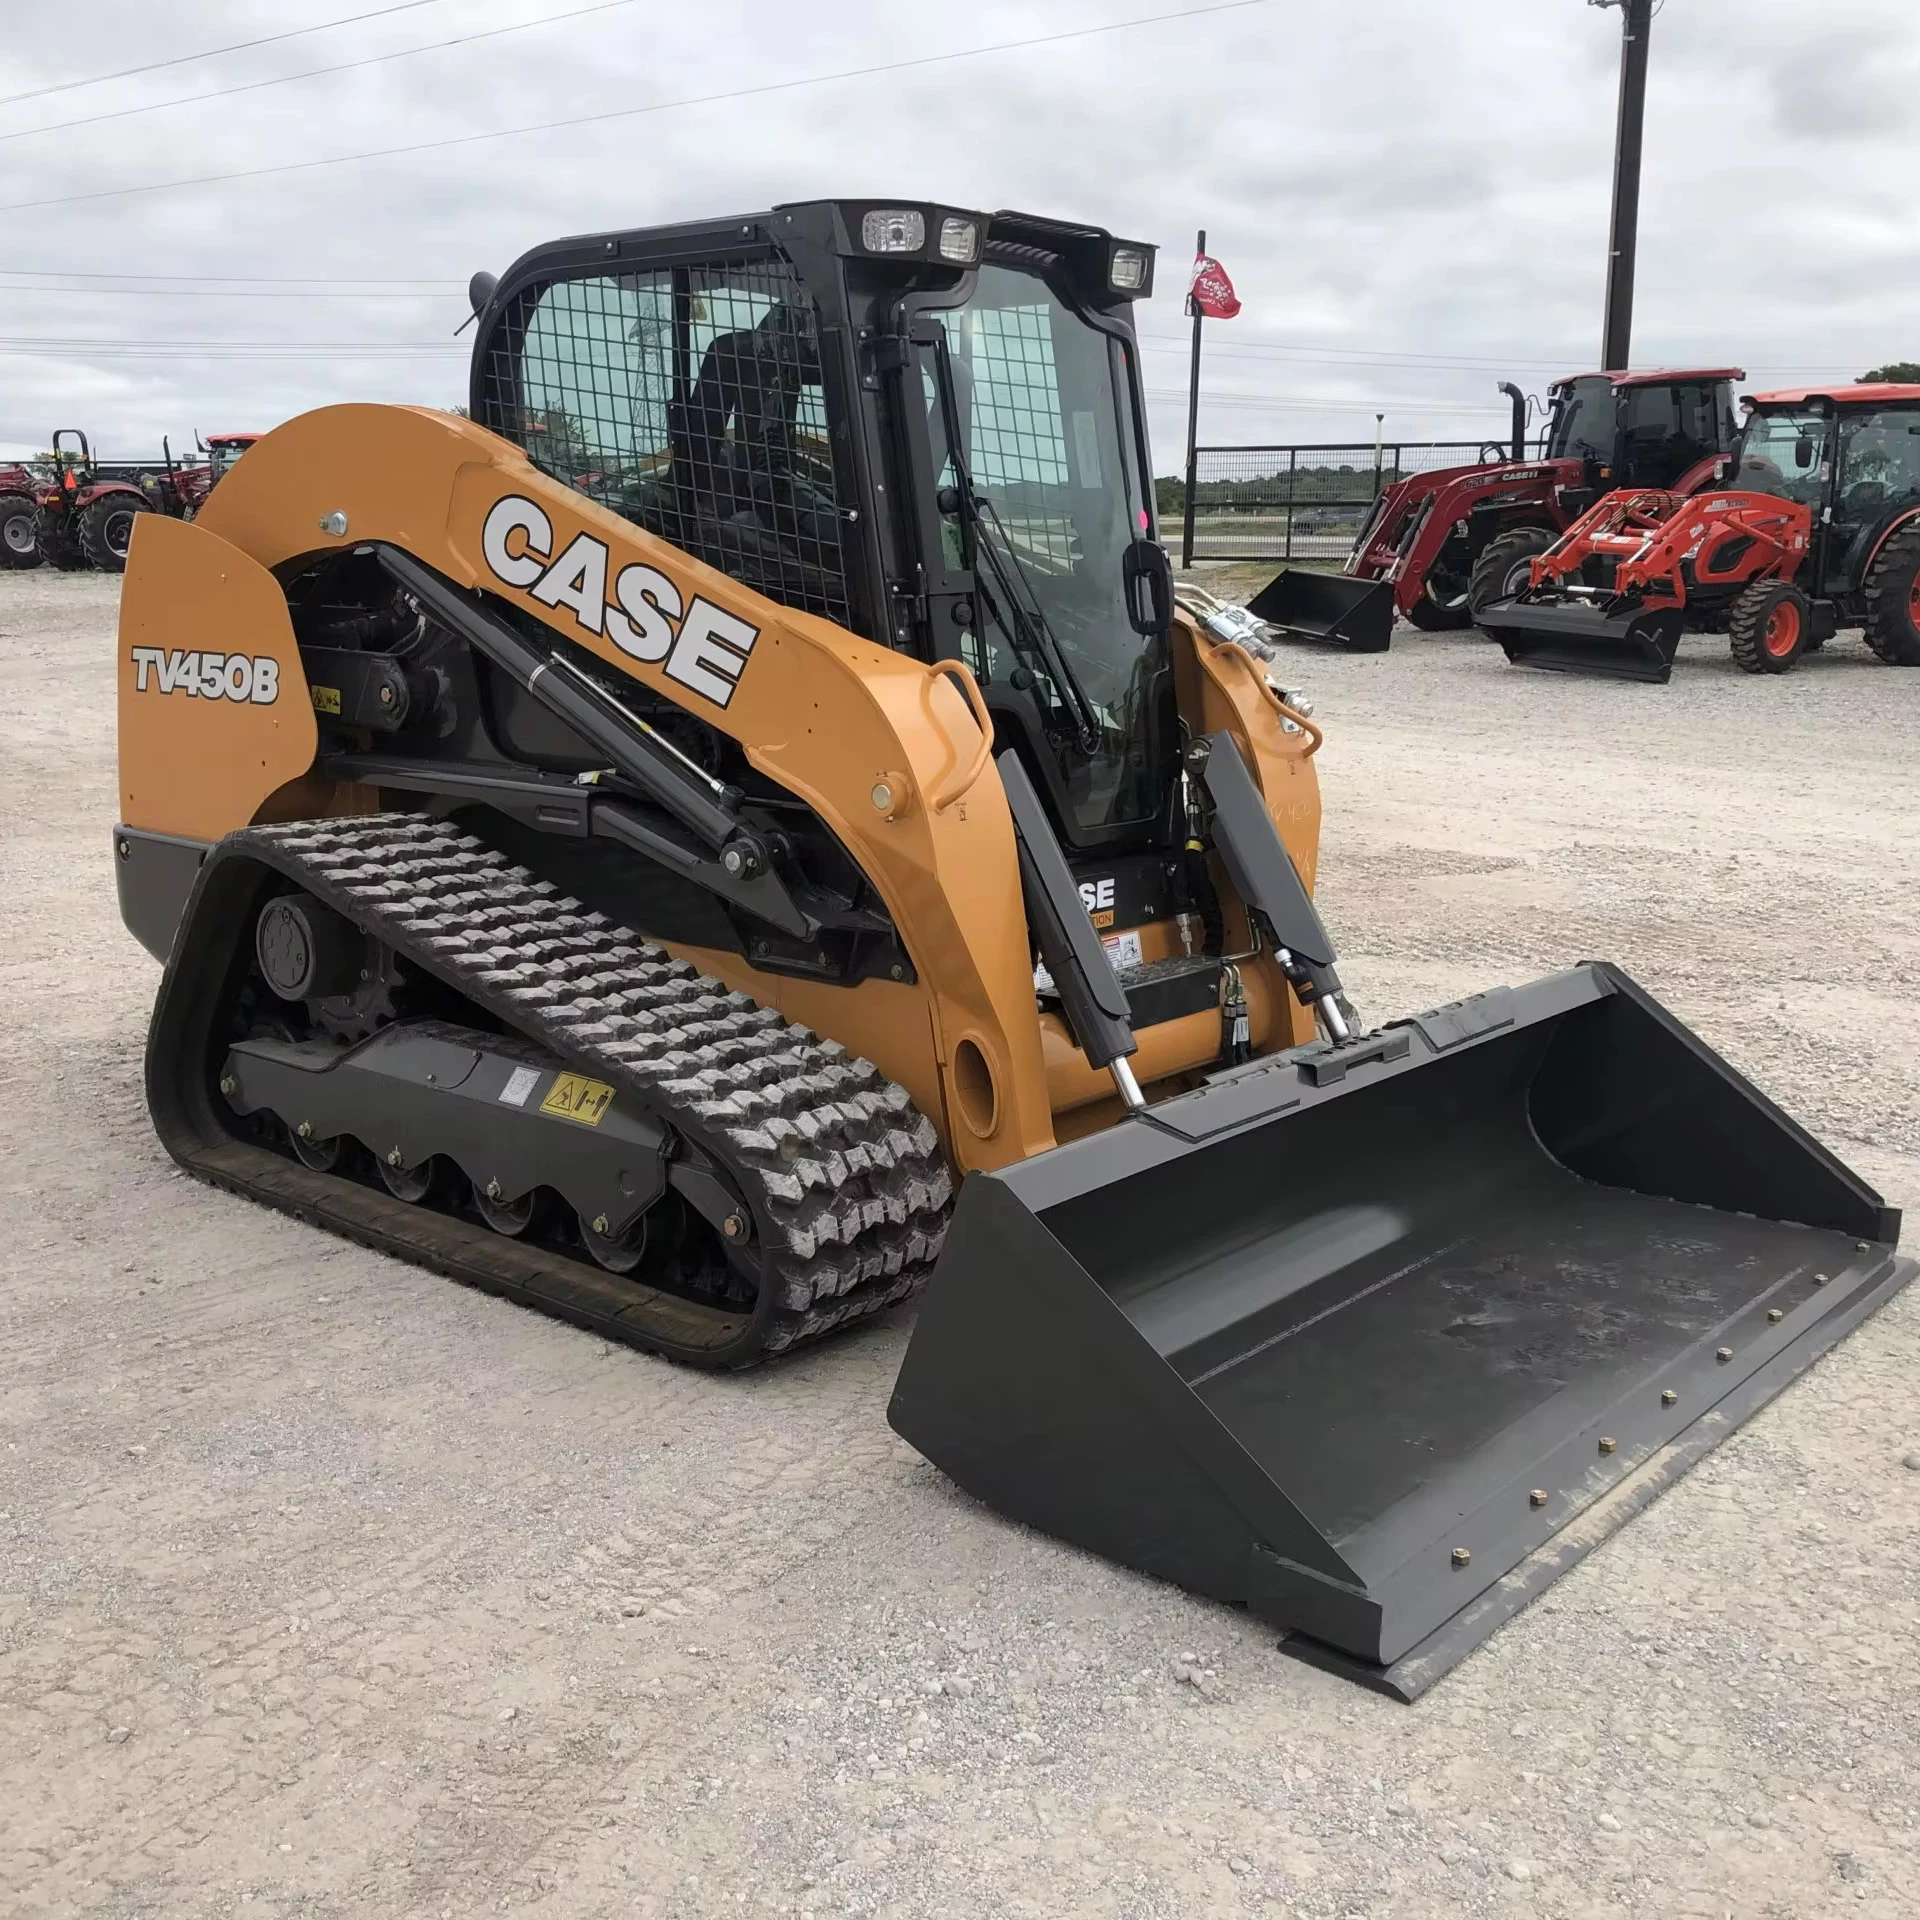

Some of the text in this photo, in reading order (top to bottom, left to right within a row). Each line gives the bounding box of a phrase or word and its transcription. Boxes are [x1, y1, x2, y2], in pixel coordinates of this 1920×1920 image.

[1502, 471, 1528, 481] CASE
[482, 494, 761, 710] CASE
[131, 645, 280, 706] TV450B
[1078, 878, 1115, 912] SE
